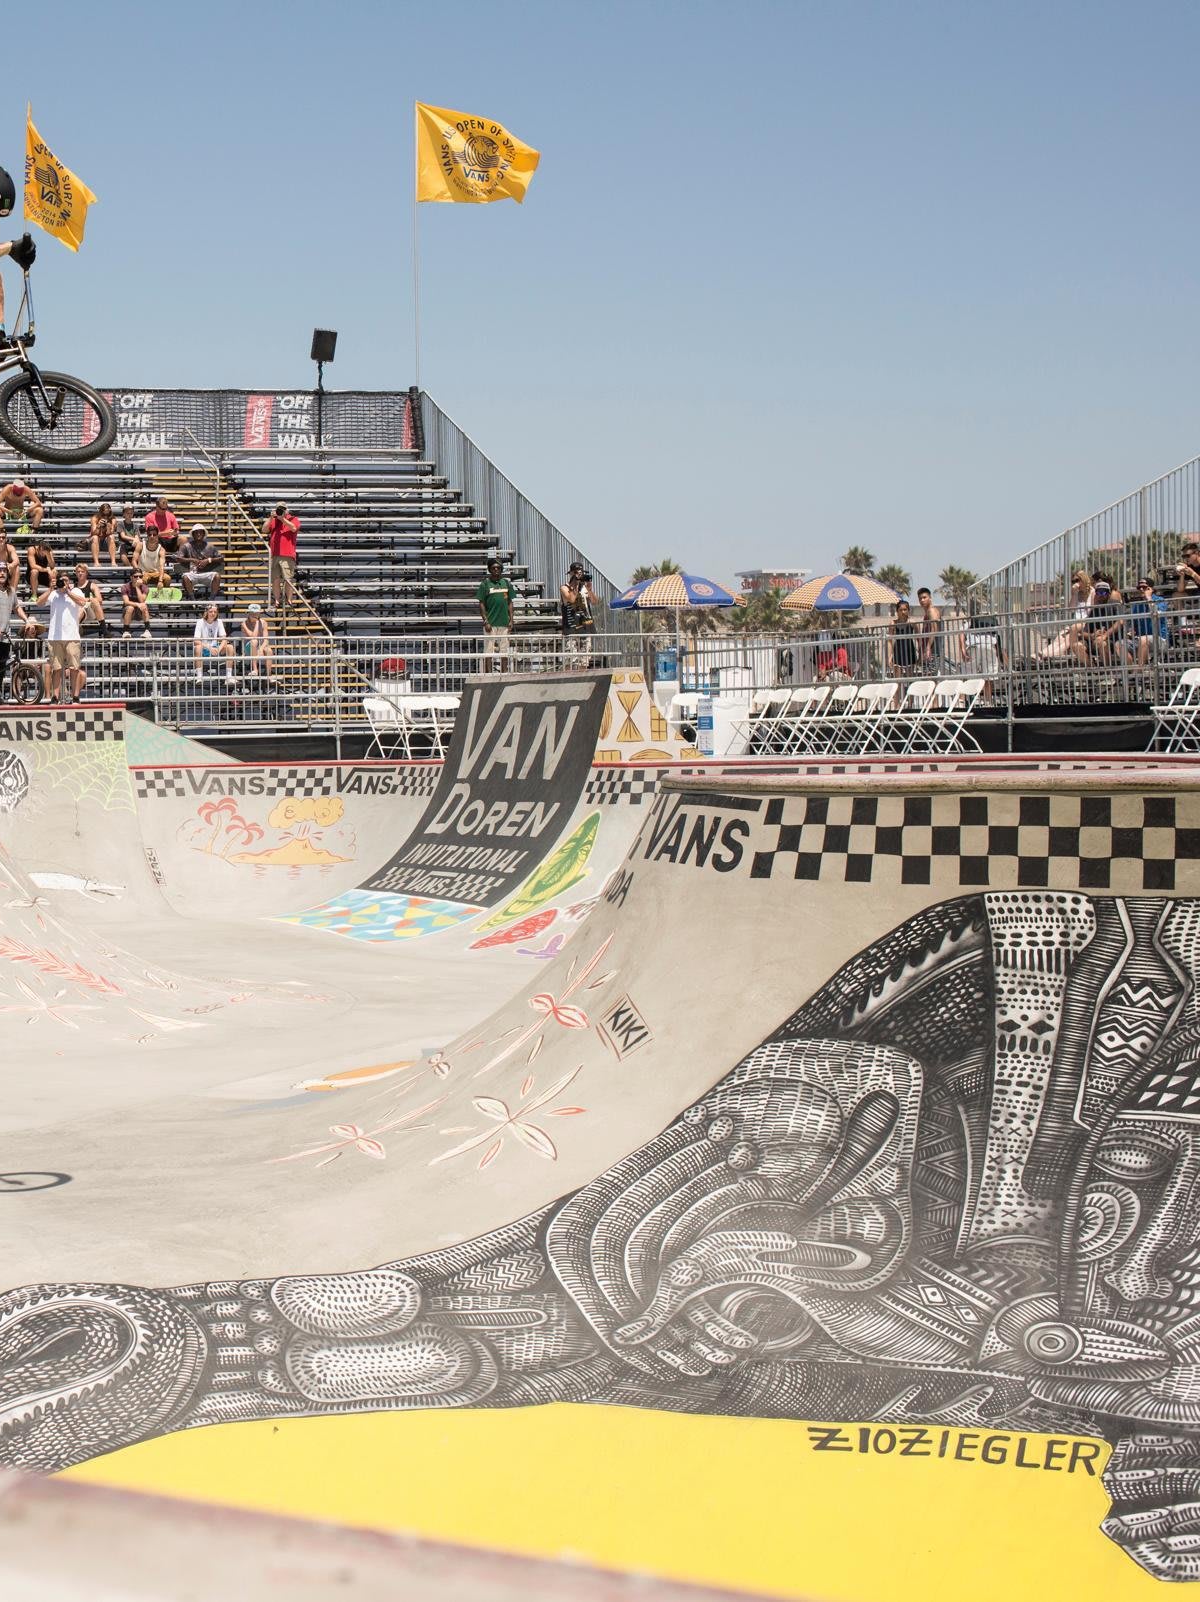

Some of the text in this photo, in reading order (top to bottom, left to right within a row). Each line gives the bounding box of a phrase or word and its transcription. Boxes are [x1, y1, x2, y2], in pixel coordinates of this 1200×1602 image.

[441, 143, 455, 177] VANS
[456, 119, 486, 133] OPEN
[490, 125, 503, 137] OF
[462, 166, 491, 183] VANS
[118, 413, 152, 428] THE
[278, 414, 312, 429] THE
[455, 681, 597, 781] VAN
[185, 768, 266, 797] VANS
[336, 766, 397, 796] VANS
[423, 782, 561, 838] DOREN
[643, 793, 763, 873] VANS
[399, 842, 529, 874] INVITATIONAL
[407, 870, 455, 898] VANS
[604, 999, 650, 1054] KIKI
